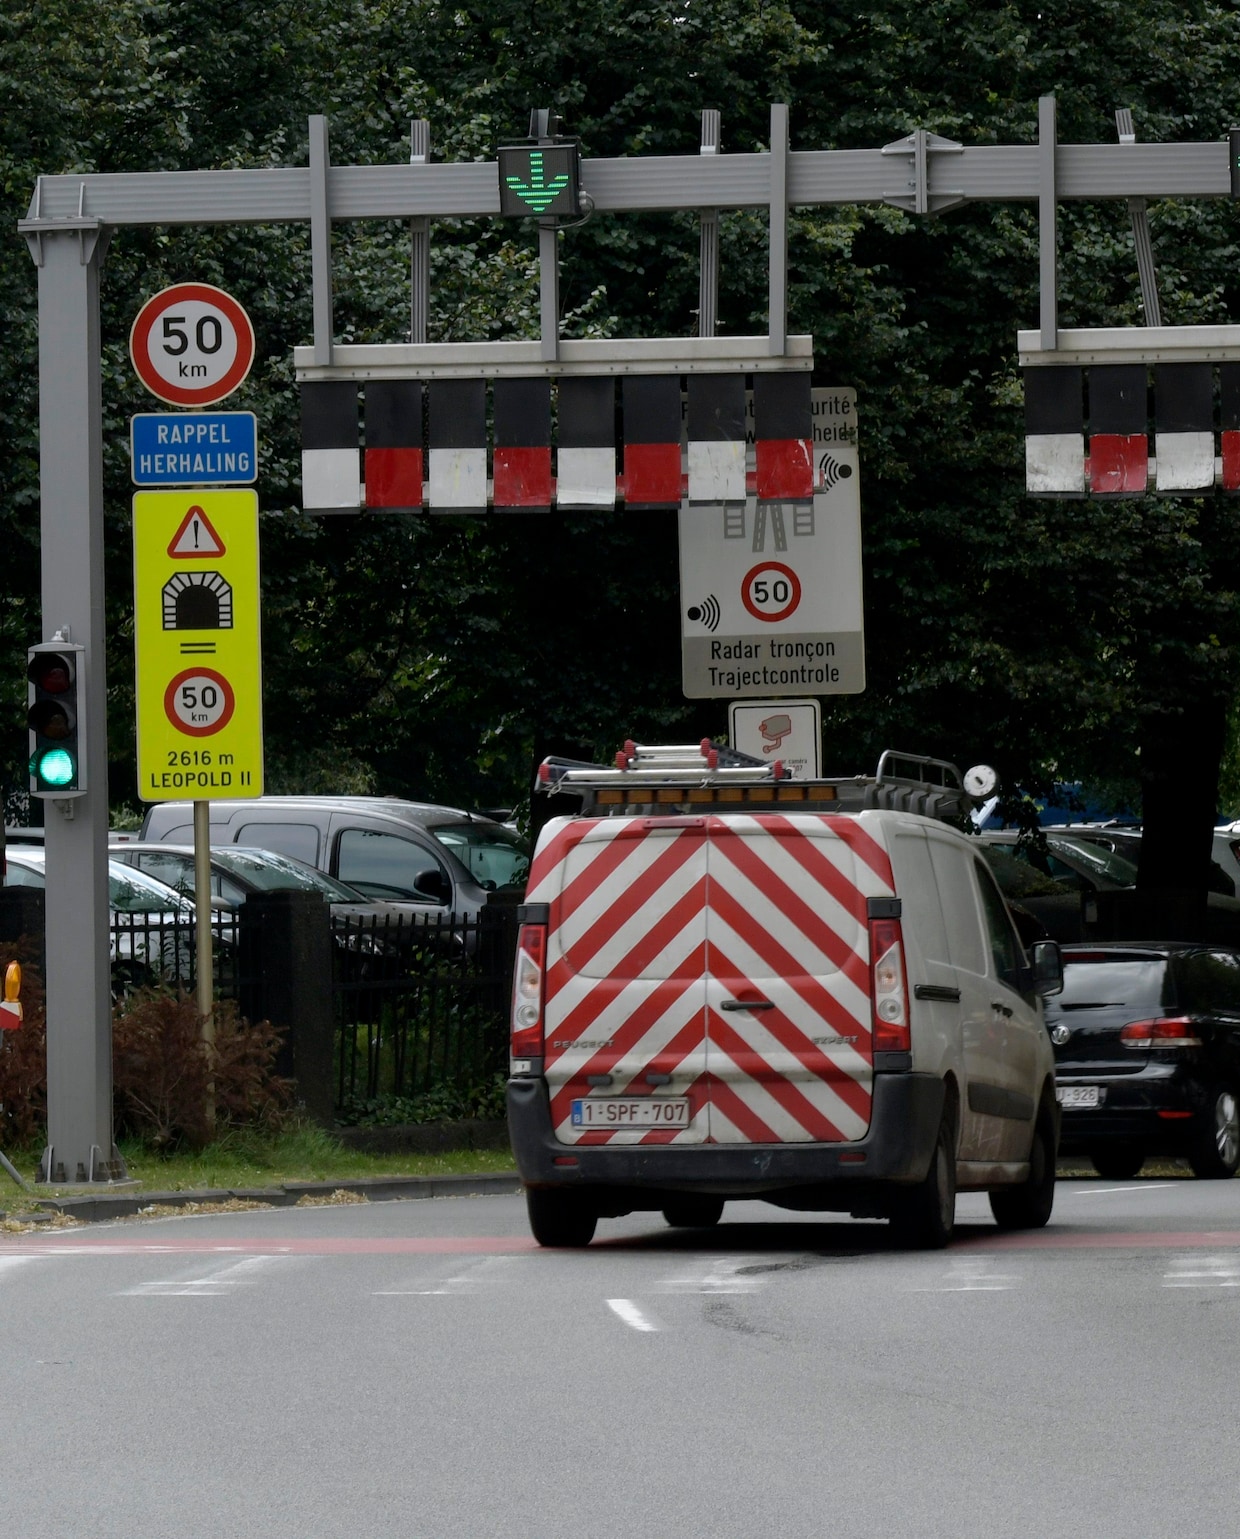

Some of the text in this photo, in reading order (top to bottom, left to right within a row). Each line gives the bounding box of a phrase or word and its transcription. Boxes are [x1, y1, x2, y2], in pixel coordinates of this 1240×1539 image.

[162, 315, 223, 356] 50
[179, 361, 207, 377] km
[157, 423, 231, 444] RAPPEL
[140, 452, 249, 474] HERHALING
[754, 580, 789, 604] 50
[711, 639, 835, 662] Radar tronçon
[708, 663, 840, 691] Trajectcontrole
[181, 686, 218, 710] 50
[191, 711, 208, 723] km
[167, 751, 234, 766] 2616 m
[151, 770, 251, 788] LEOPOLD II
[553, 1039, 616, 1049] PEUGEOT
[812, 1034, 859, 1045] EXPERT
